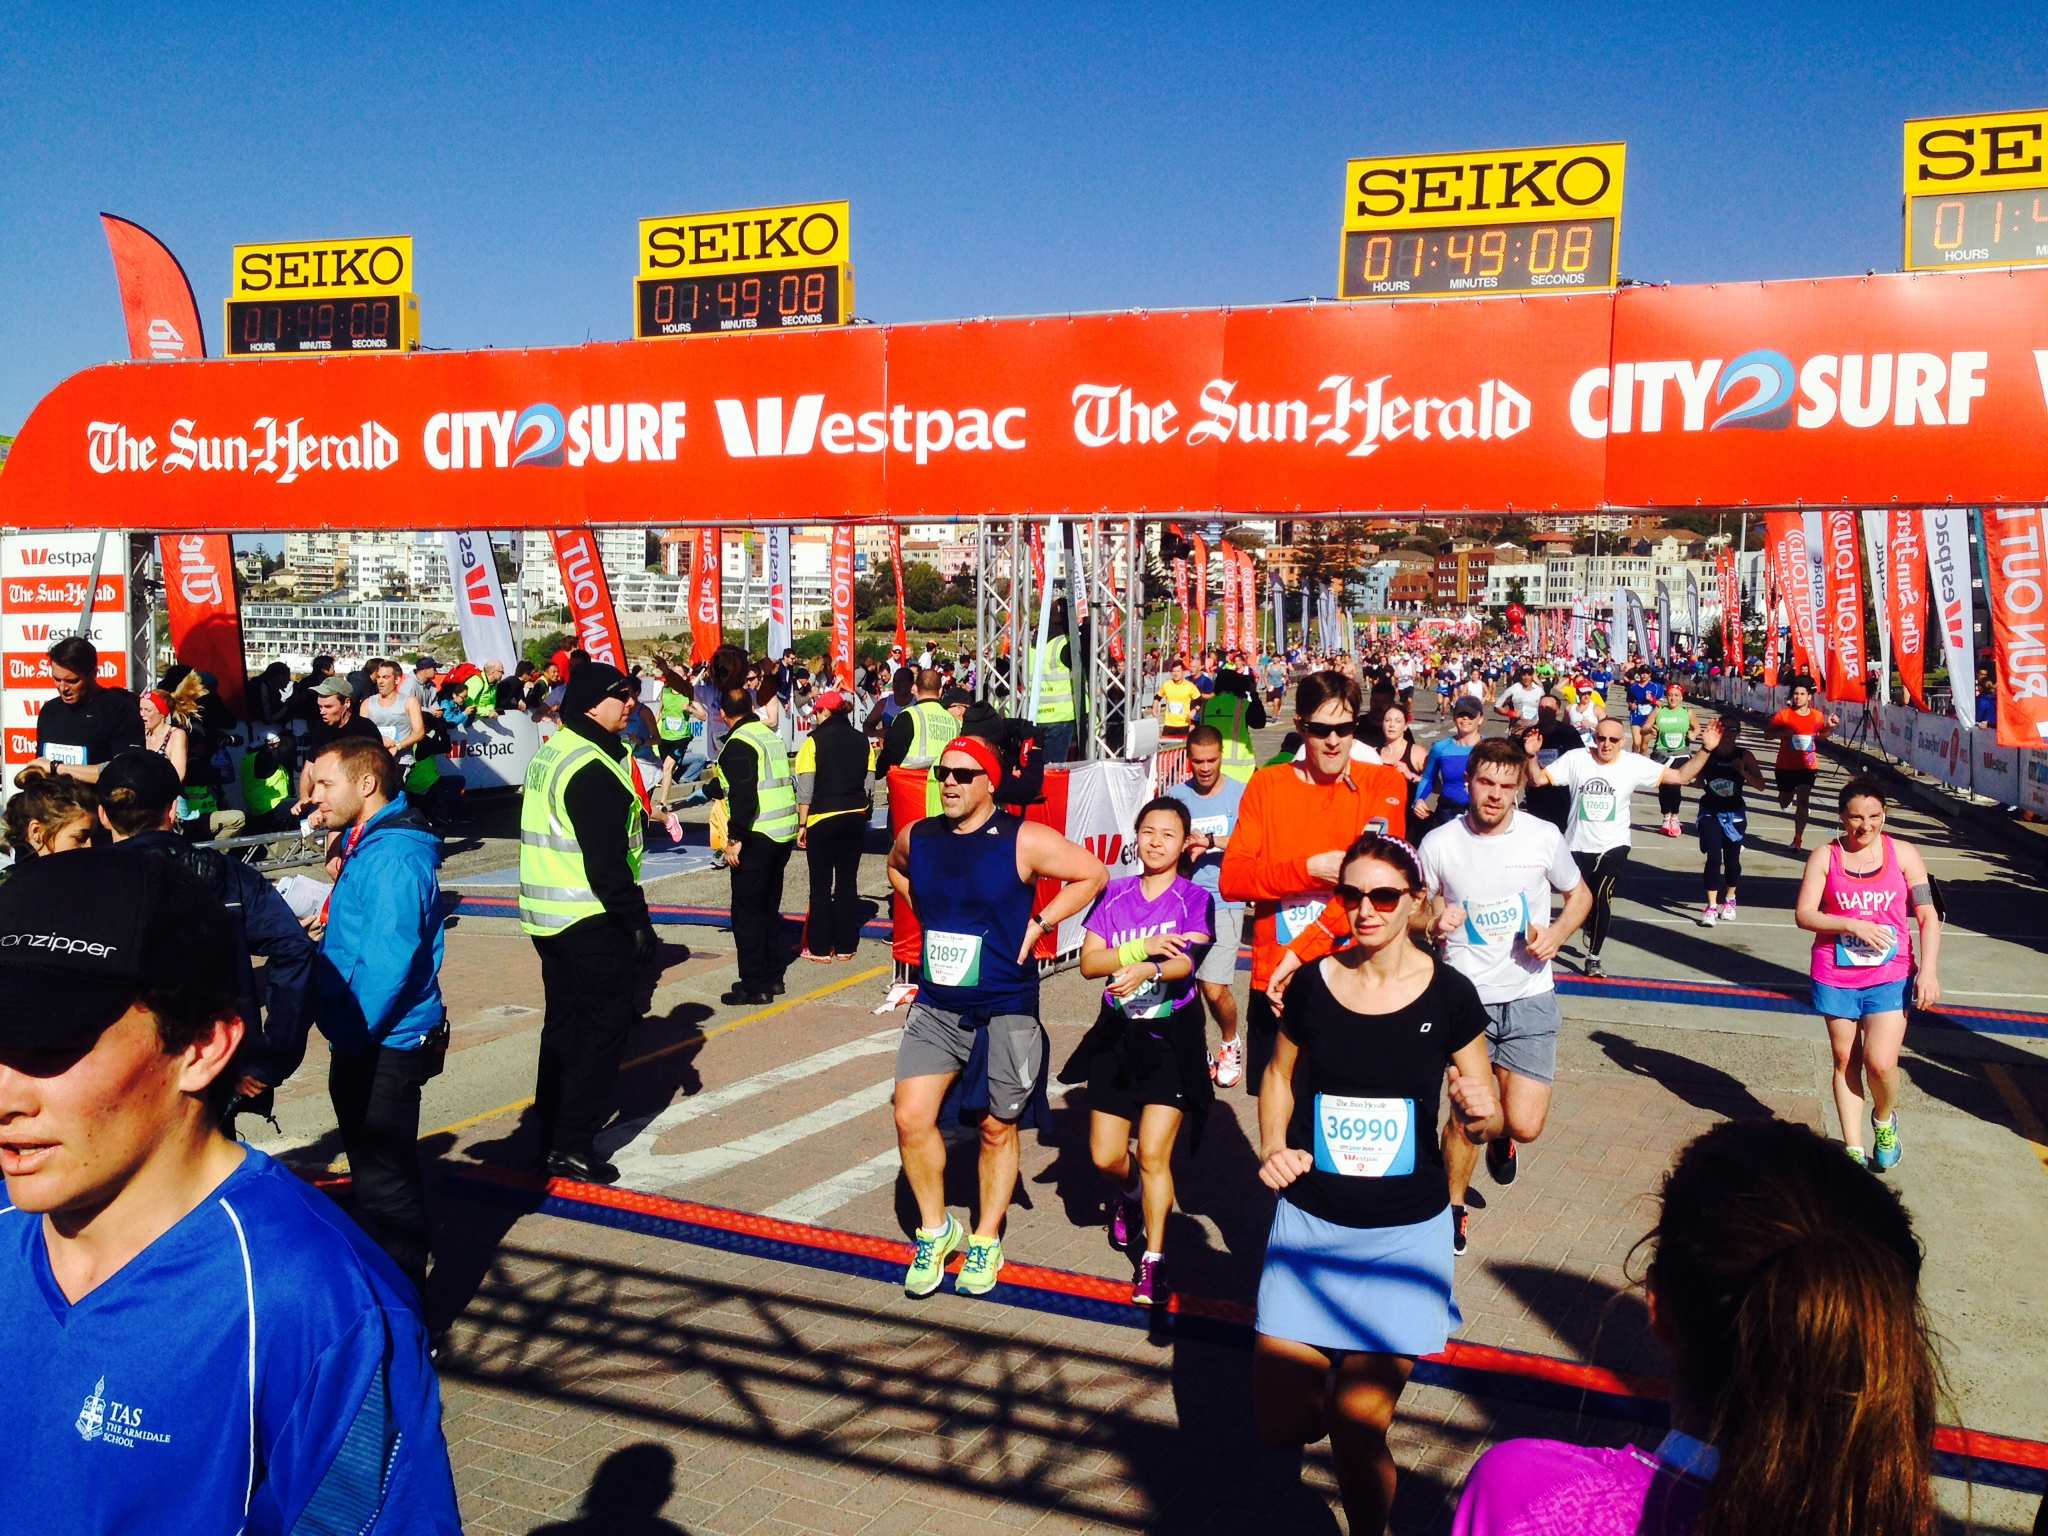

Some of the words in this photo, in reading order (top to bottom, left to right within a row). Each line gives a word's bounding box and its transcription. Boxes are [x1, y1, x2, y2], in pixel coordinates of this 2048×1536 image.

[1357, 156, 1611, 217] SEIKO
[648, 213, 839, 268] SEIKO
[1363, 226, 1593, 282] 01:49:08
[1945, 249, 1990, 261] HOURS
[2036, 245, 2048, 257] M
[241, 246, 404, 291] SEIKO
[1372, 280, 1411, 292] HOURS
[1449, 277, 1498, 289] MINUTES
[1531, 273, 1585, 286] SECONDS
[654, 273, 825, 324] 01:49:08
[662, 323, 692, 333] HOURS
[720, 319, 757, 330] MINUTES
[781, 314, 823, 326] SECONDS
[249, 342, 276, 351] HOURS
[299, 340, 332, 350] MINUTES
[351, 339, 388, 349] SECONDS
[87, 420, 157, 475] The
[162, 416, 399, 484] Sun-Herald
[713, 394, 1027, 465] Westpac
[1071, 382, 1180, 448] The
[1186, 374, 1532, 457] Sun-Herald
[9, 584, 34, 603] The
[35, 582, 117, 608] Sun-Heald
[9, 659, 36, 679] The
[12, 734, 38, 754] The
[447, 740, 514, 760] Westpac
[1835, 890, 1897, 912] HAPPY
[1475, 907, 1517, 926] 41039
[929, 944, 967, 964] 21897
[1327, 1115, 1398, 1142] 36990
[110, 1400, 143, 1428] TAS
[102, 1432, 135, 1449] SCHOOL
[106, 1421, 122, 1434] THE
[123, 1427, 172, 1444] ARMIDALE
